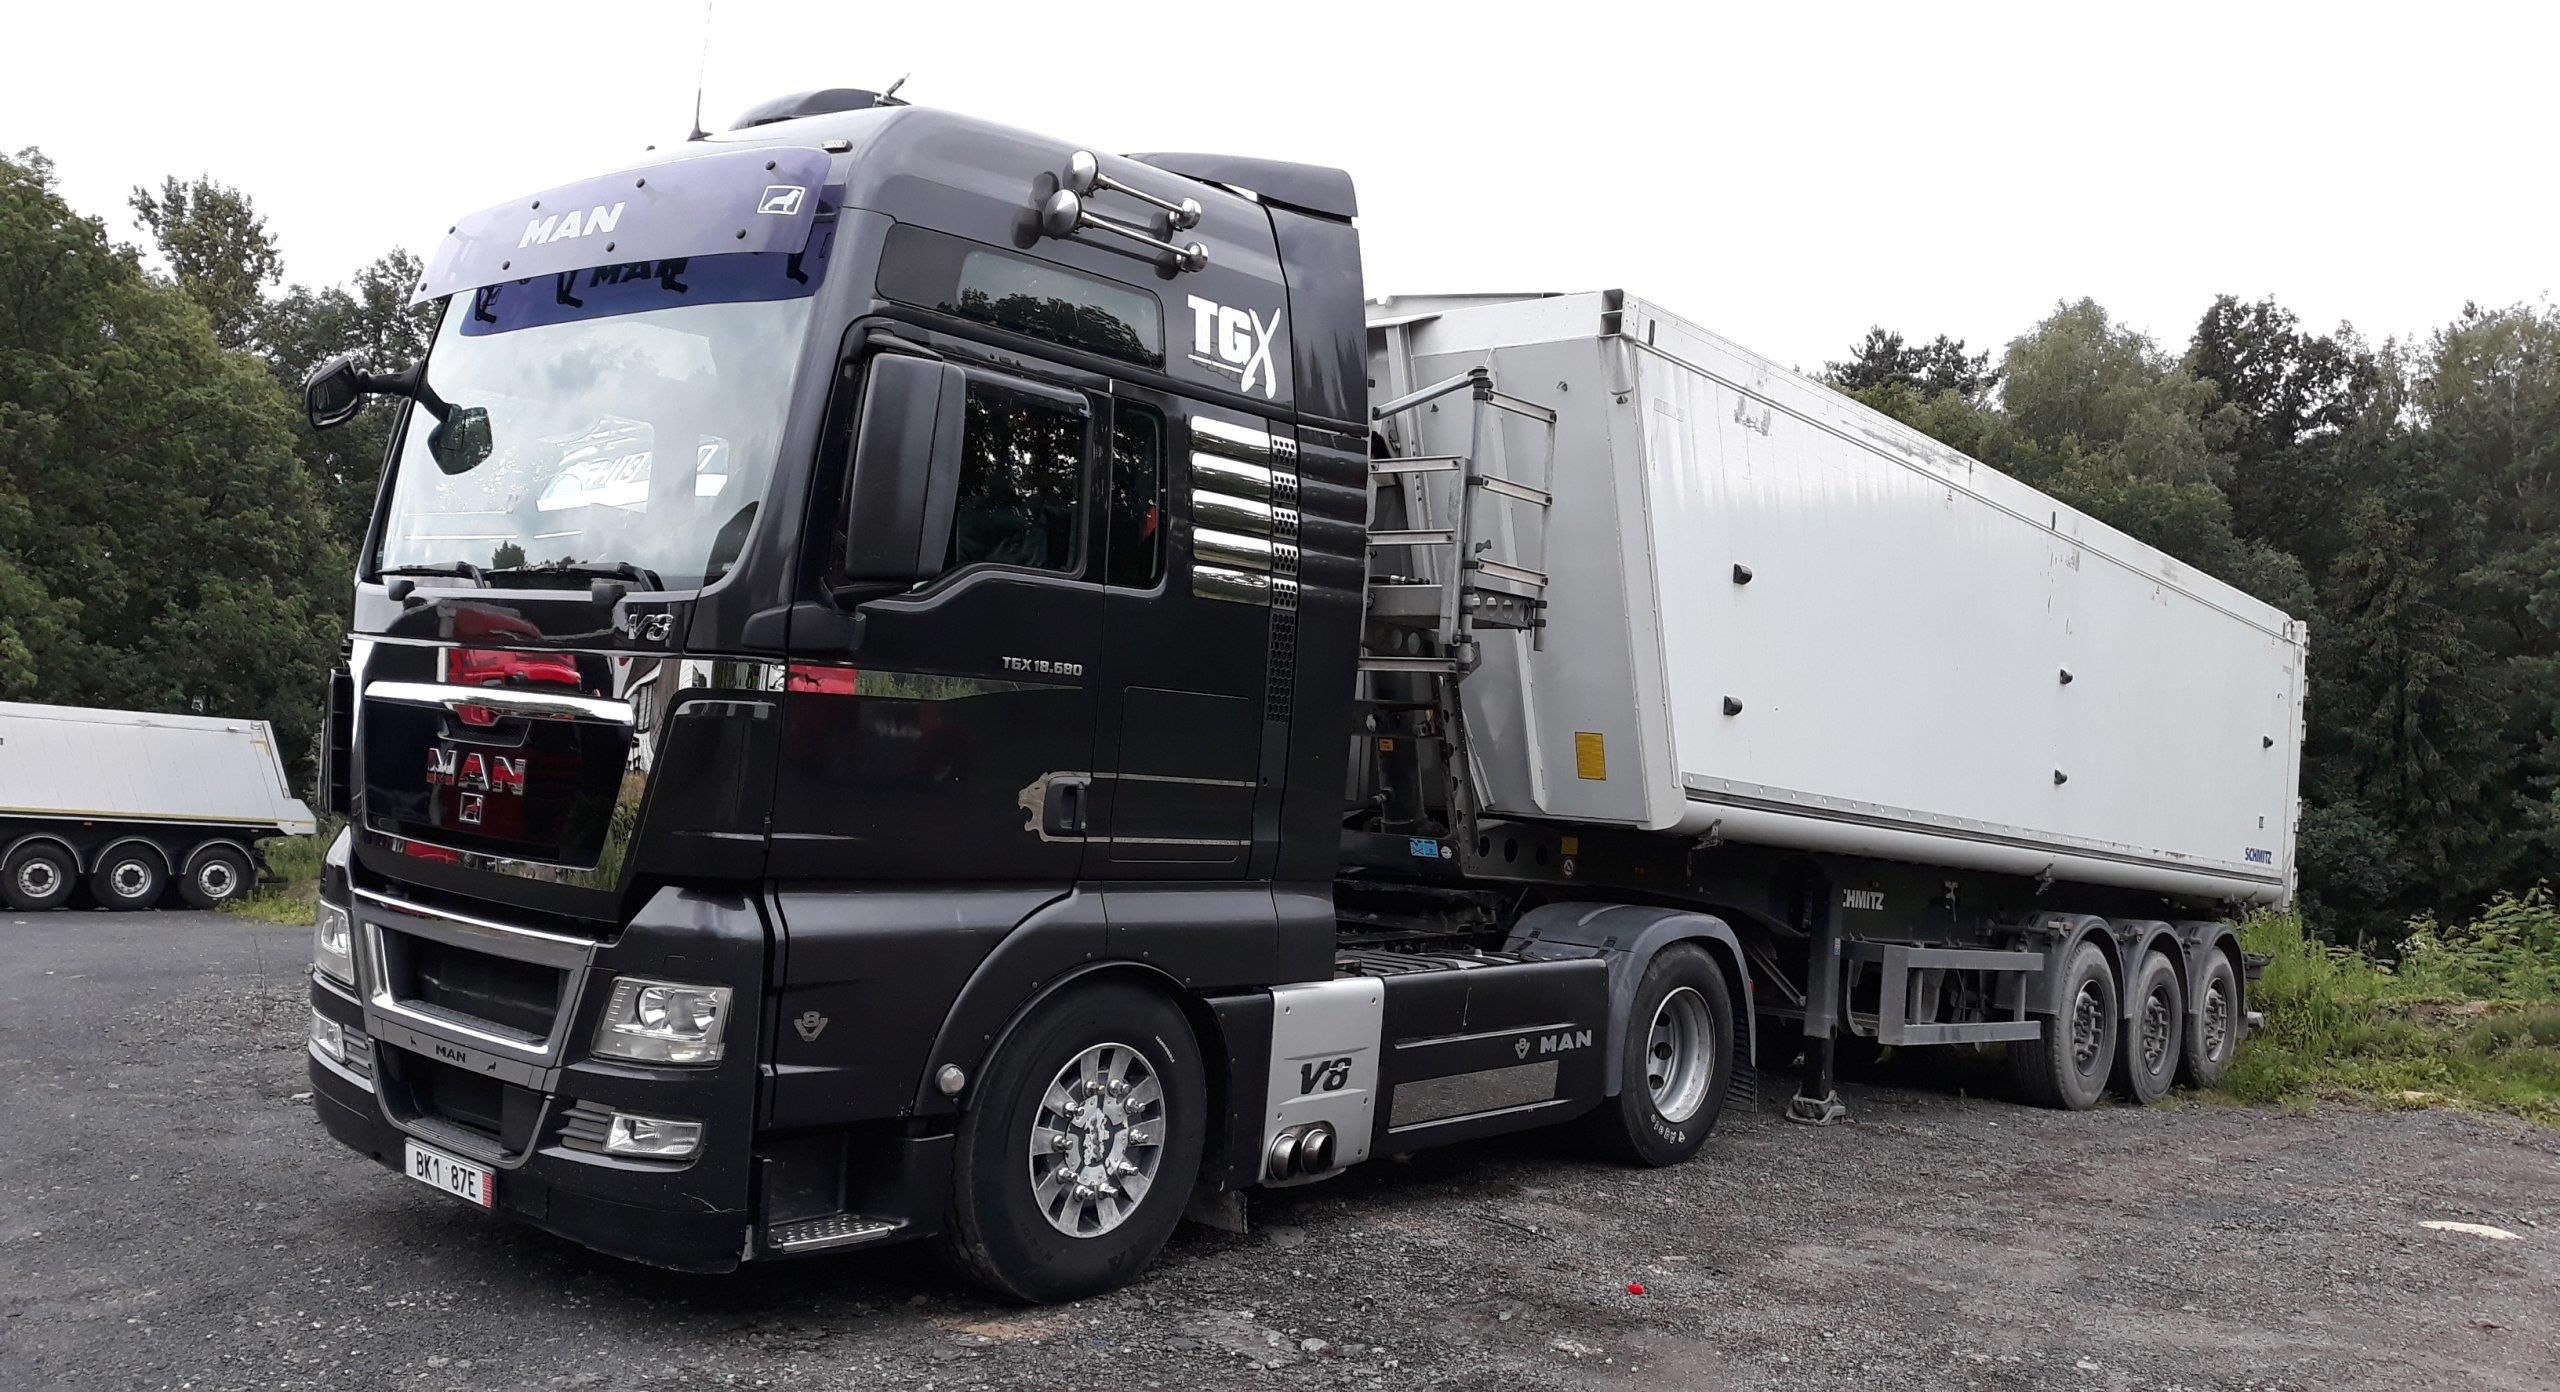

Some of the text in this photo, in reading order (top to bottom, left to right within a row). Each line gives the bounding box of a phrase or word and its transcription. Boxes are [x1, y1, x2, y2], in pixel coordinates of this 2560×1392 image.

[518, 201, 626, 248] MAN
[1187, 294, 1281, 399] TGX
[625, 613, 674, 642] V8
[1002, 656, 1032, 671] TGX
[425, 747, 528, 796] MAN
[2245, 847, 2272, 864] SCHMITZ
[1843, 888, 1884, 910] HMITZ
[435, 1044, 466, 1063] MAN
[1540, 1029, 1592, 1054] MAN
[1300, 1056, 1353, 1095] V8
[416, 1151, 476, 1198] BK1 87E
